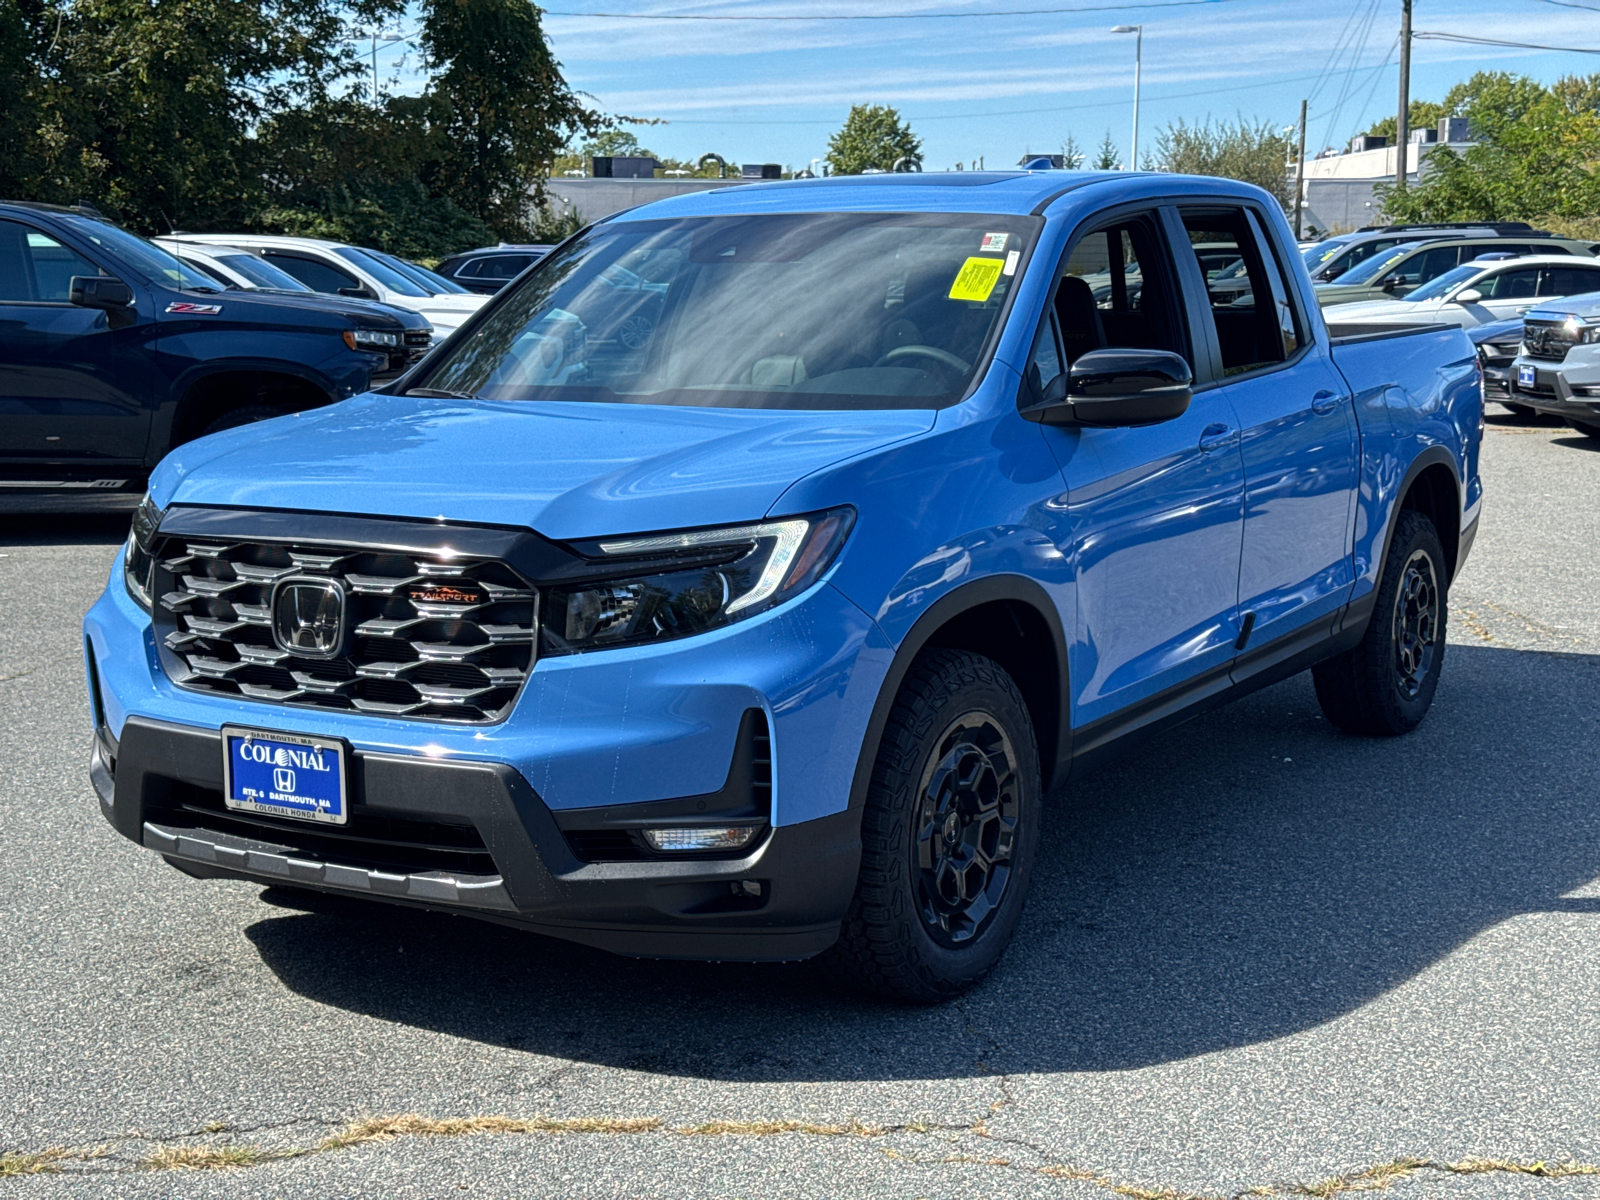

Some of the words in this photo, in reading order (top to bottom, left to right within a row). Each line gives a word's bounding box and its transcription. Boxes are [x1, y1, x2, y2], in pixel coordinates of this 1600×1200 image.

[165, 302, 222, 315] Z71
[410, 591, 478, 603] TRAILSPORT
[240, 743, 330, 772] COLONIAL
[242, 787, 258, 798] RTE.
[259, 790, 265, 798] 6
[269, 792, 318, 807] DARTMOUTH,
[318, 799, 331, 808] MA
[254, 803, 289, 816] COLONIAL
[290, 808, 316, 819] HONDA
